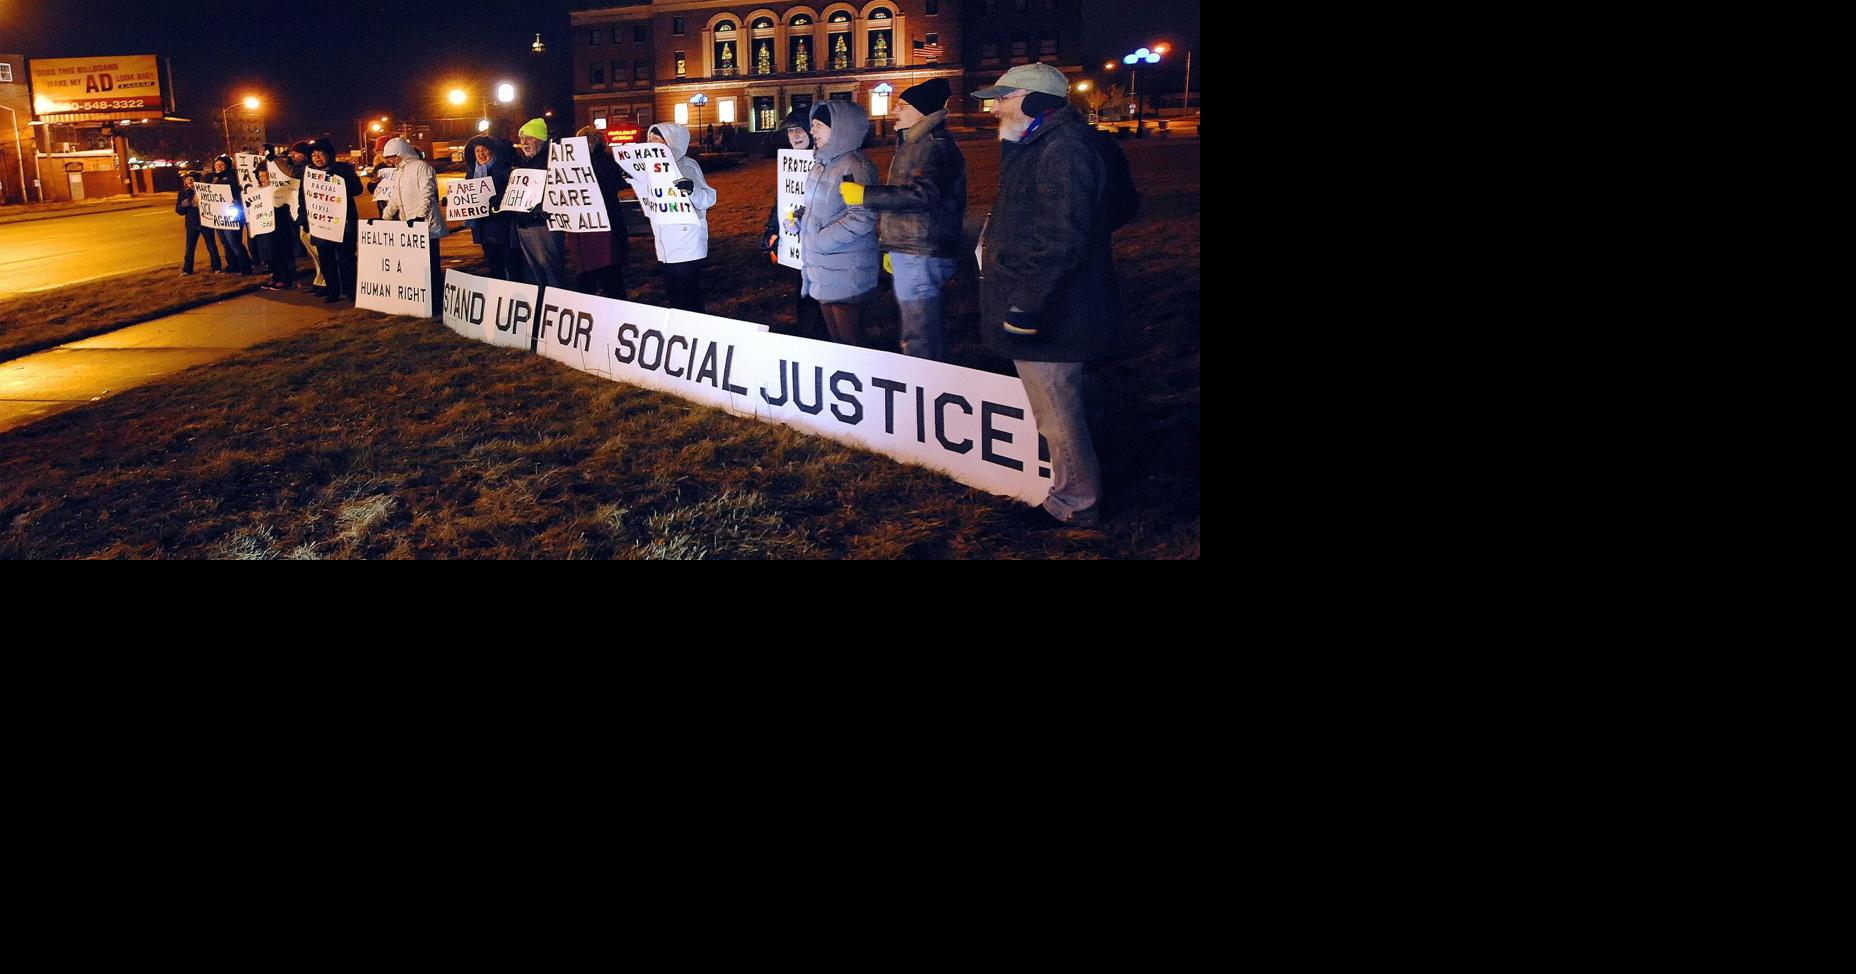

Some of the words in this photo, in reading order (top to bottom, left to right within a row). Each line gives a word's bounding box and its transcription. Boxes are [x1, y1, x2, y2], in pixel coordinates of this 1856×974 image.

[86, 73, 114, 93] AD
[71, 99, 144, 111] 0-548-3322
[551, 143, 576, 162] AIR
[617, 150, 631, 161] NO
[634, 147, 667, 159] HATE
[783, 156, 817, 173] PROTEC
[548, 166, 596, 184] EALTH
[195, 184, 212, 193] MAKE
[311, 182, 337, 192] RACIAL
[456, 183, 475, 194] ARE
[479, 180, 491, 193] A
[785, 178, 805, 195] HEAL
[201, 192, 226, 203] AMERICA
[307, 190, 342, 204] JUSTICE
[453, 193, 480, 206] ONE
[549, 188, 593, 207] CARE
[311, 203, 330, 213] CIVIL
[449, 205, 488, 218] AMERIC
[549, 213, 573, 230] FOR
[578, 211, 609, 230] ALL
[361, 231, 395, 247] HEALTH
[400, 233, 426, 249] CARE
[381, 258, 390, 272] IS
[396, 258, 402, 273] A
[360, 281, 391, 297] HUMAN
[398, 285, 427, 303] RIGHT
[443, 282, 486, 326] STAND
[495, 296, 533, 335] UP
[540, 304, 594, 352] FOR
[614, 322, 748, 396] SOCIAL
[760, 358, 1051, 479] JUSTICE!
